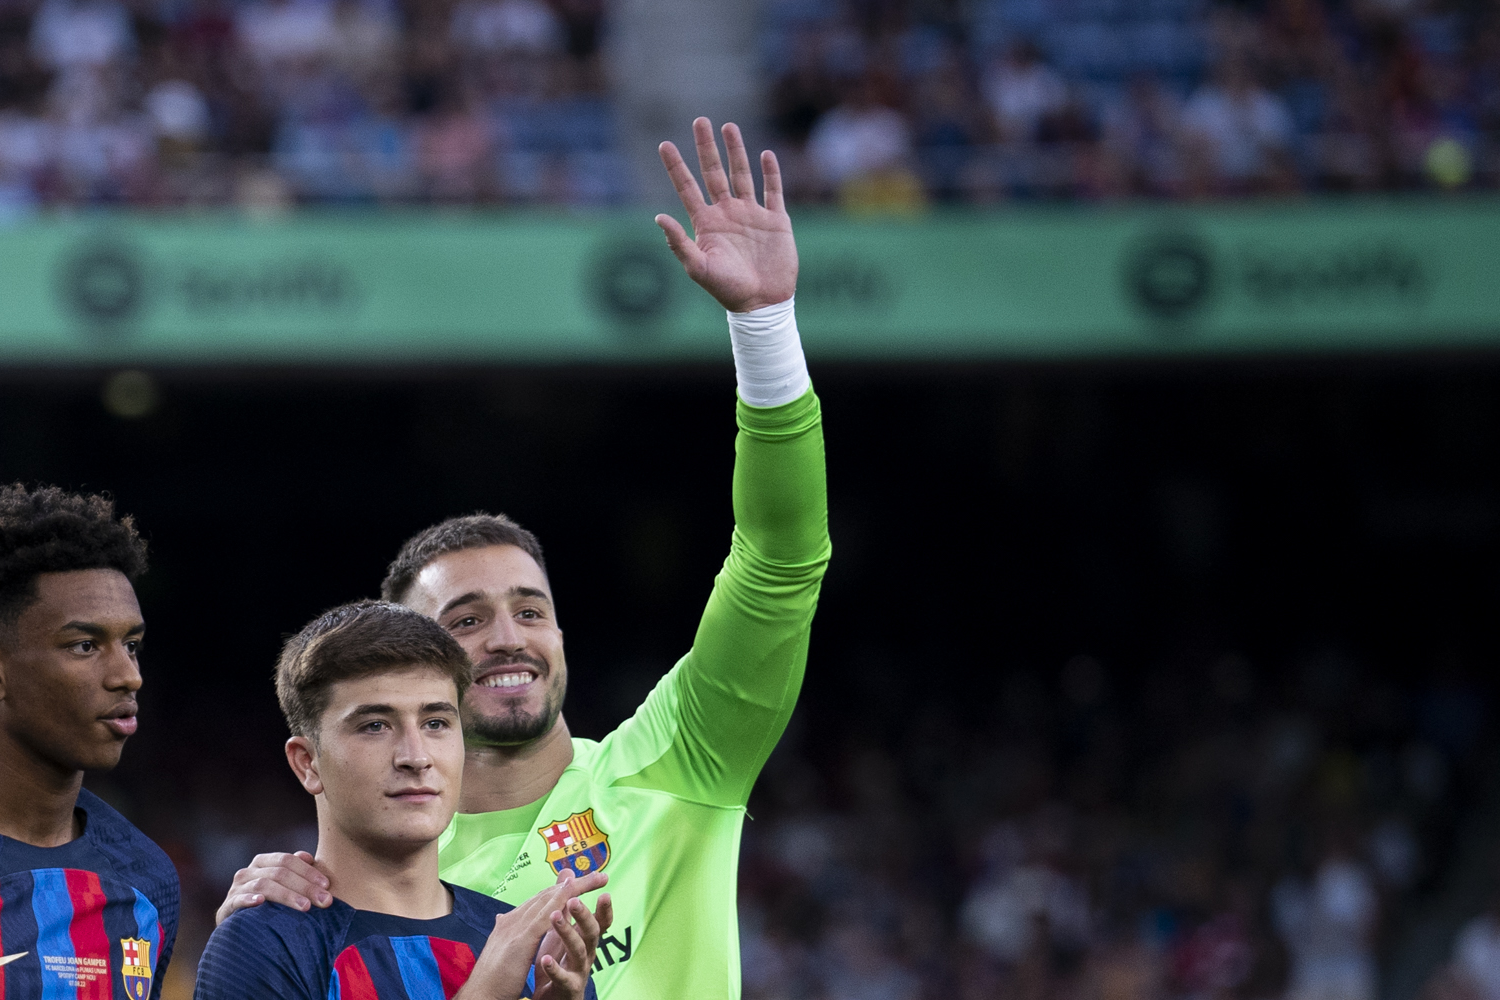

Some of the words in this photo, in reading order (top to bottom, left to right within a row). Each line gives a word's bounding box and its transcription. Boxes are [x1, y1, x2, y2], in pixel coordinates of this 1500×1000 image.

[563, 840, 588, 855] FCB
[43, 956, 66, 964] TROFEU
[67, 957, 83, 965] JOAN
[83, 958, 107, 967] GAMPER
[132, 966, 145, 976] FCB
